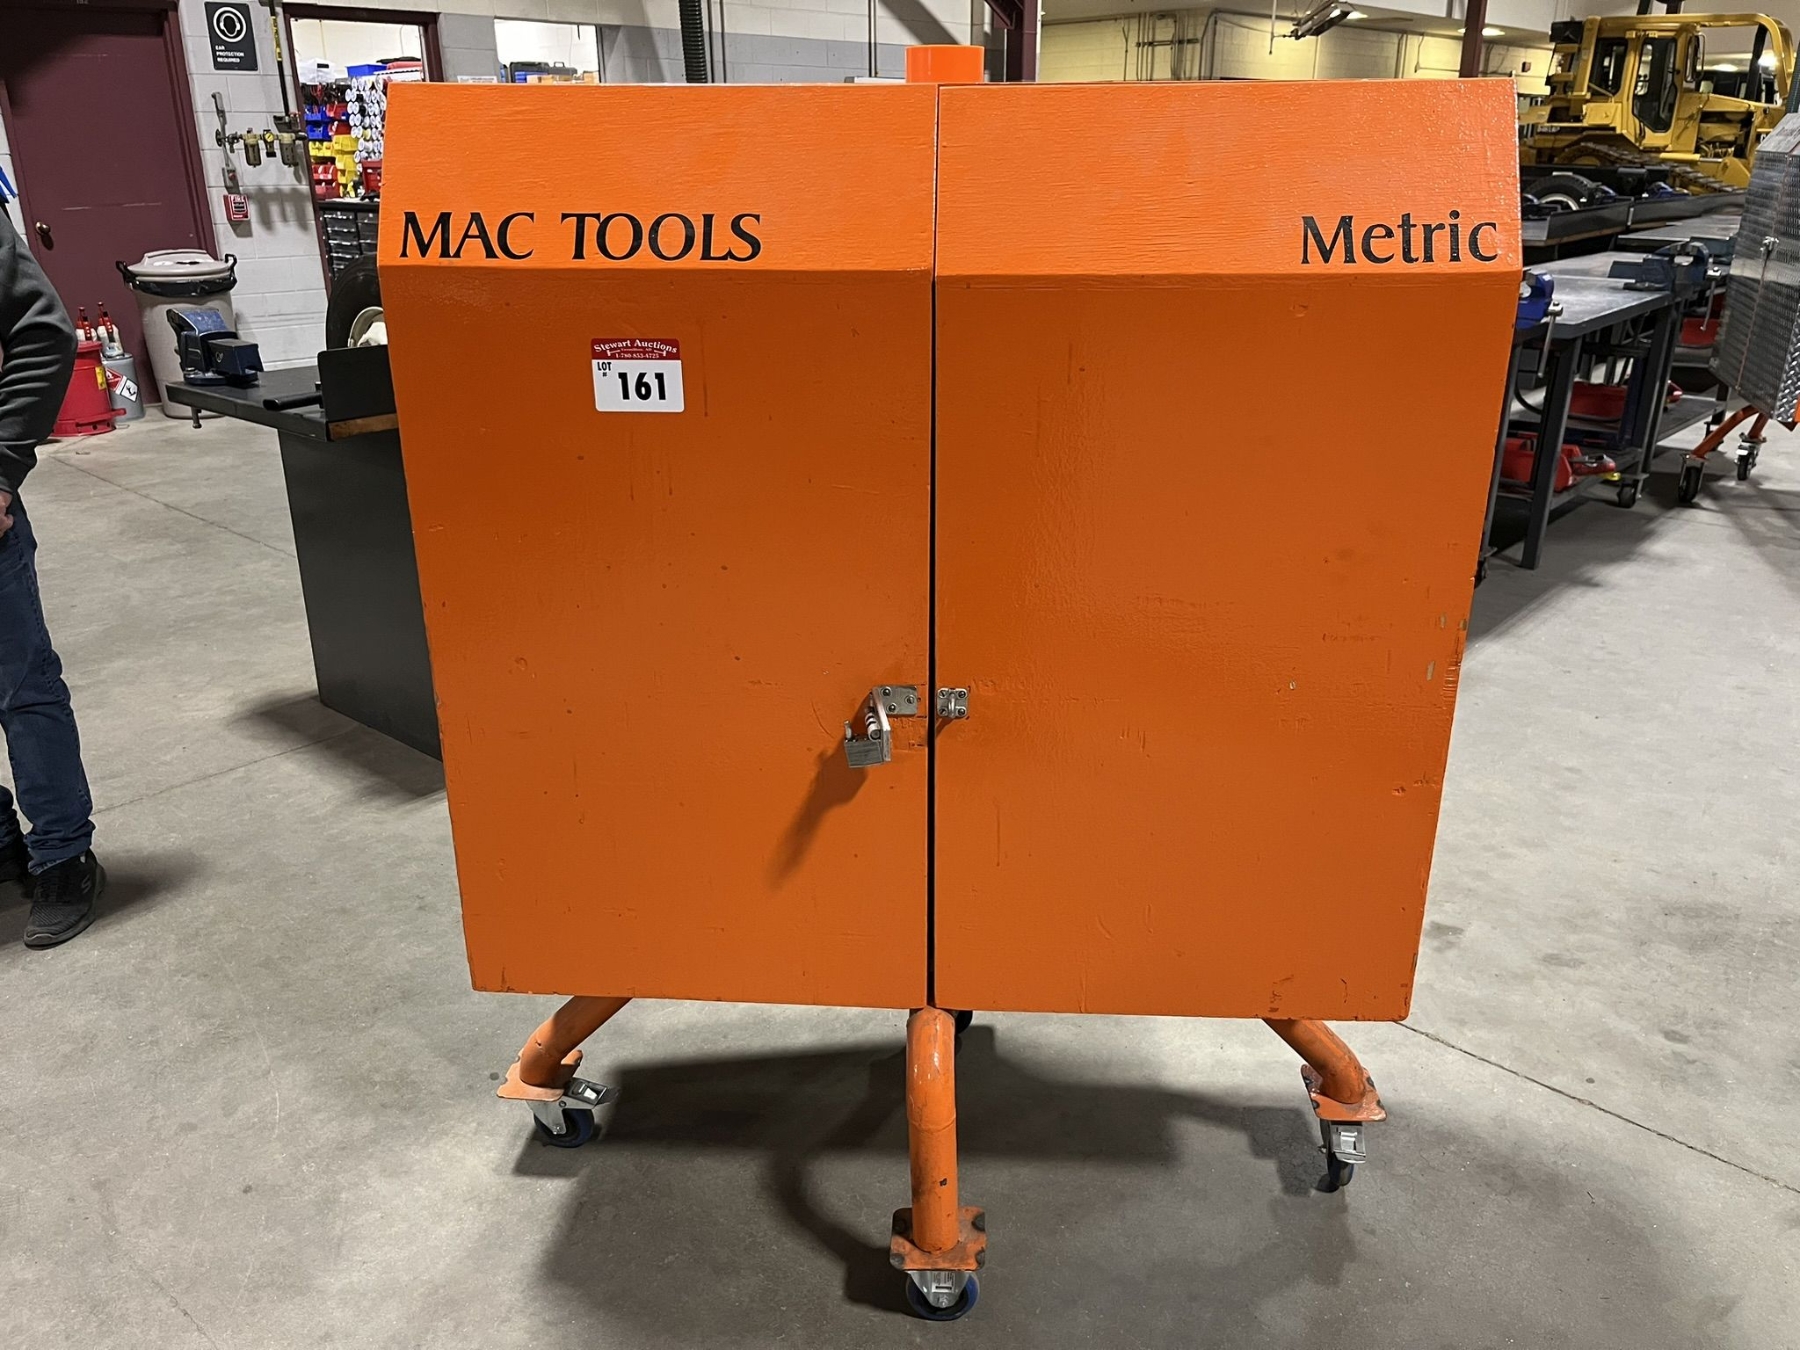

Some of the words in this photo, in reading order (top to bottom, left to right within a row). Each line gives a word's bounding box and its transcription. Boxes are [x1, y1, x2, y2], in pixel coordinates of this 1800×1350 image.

[399, 211, 535, 261] MAC
[561, 212, 763, 262] TOOLS
[1300, 209, 1499, 264] Metric
[593, 340, 631, 352] Stewart
[634, 339, 678, 353] Auctions
[597, 361, 612, 371] LOT
[618, 372, 667, 401] 161
